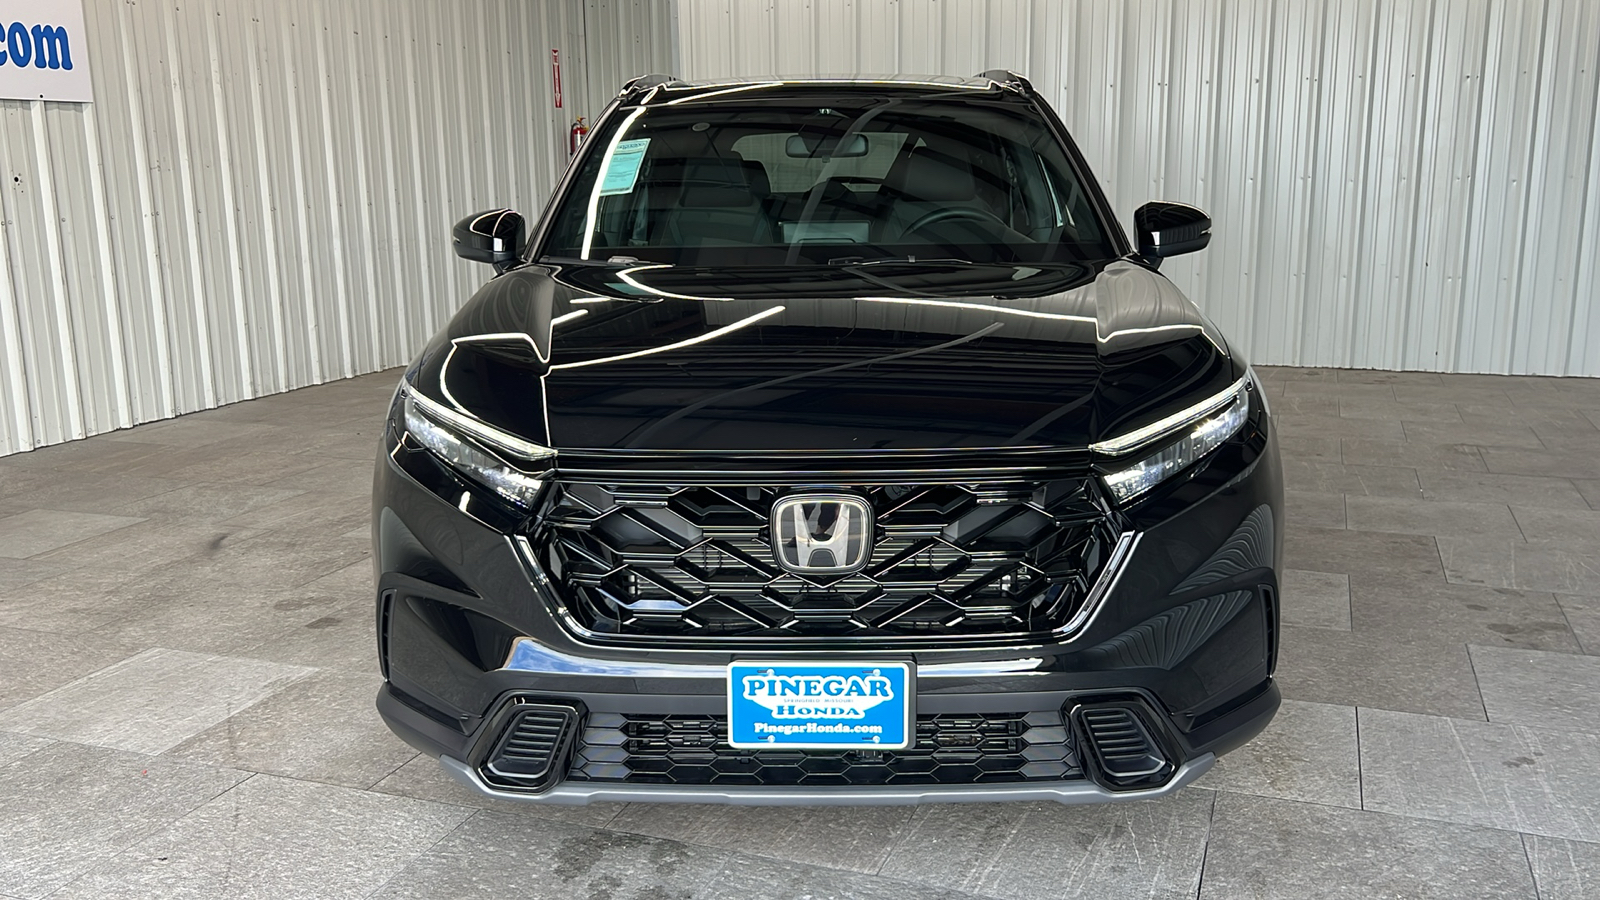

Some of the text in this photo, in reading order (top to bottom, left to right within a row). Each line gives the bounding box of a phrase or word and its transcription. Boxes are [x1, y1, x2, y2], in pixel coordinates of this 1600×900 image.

[747, 679, 889, 697] PINEGAR
[776, 705, 861, 715] HONDA
[754, 722, 882, 735] PinegarHonda.com
